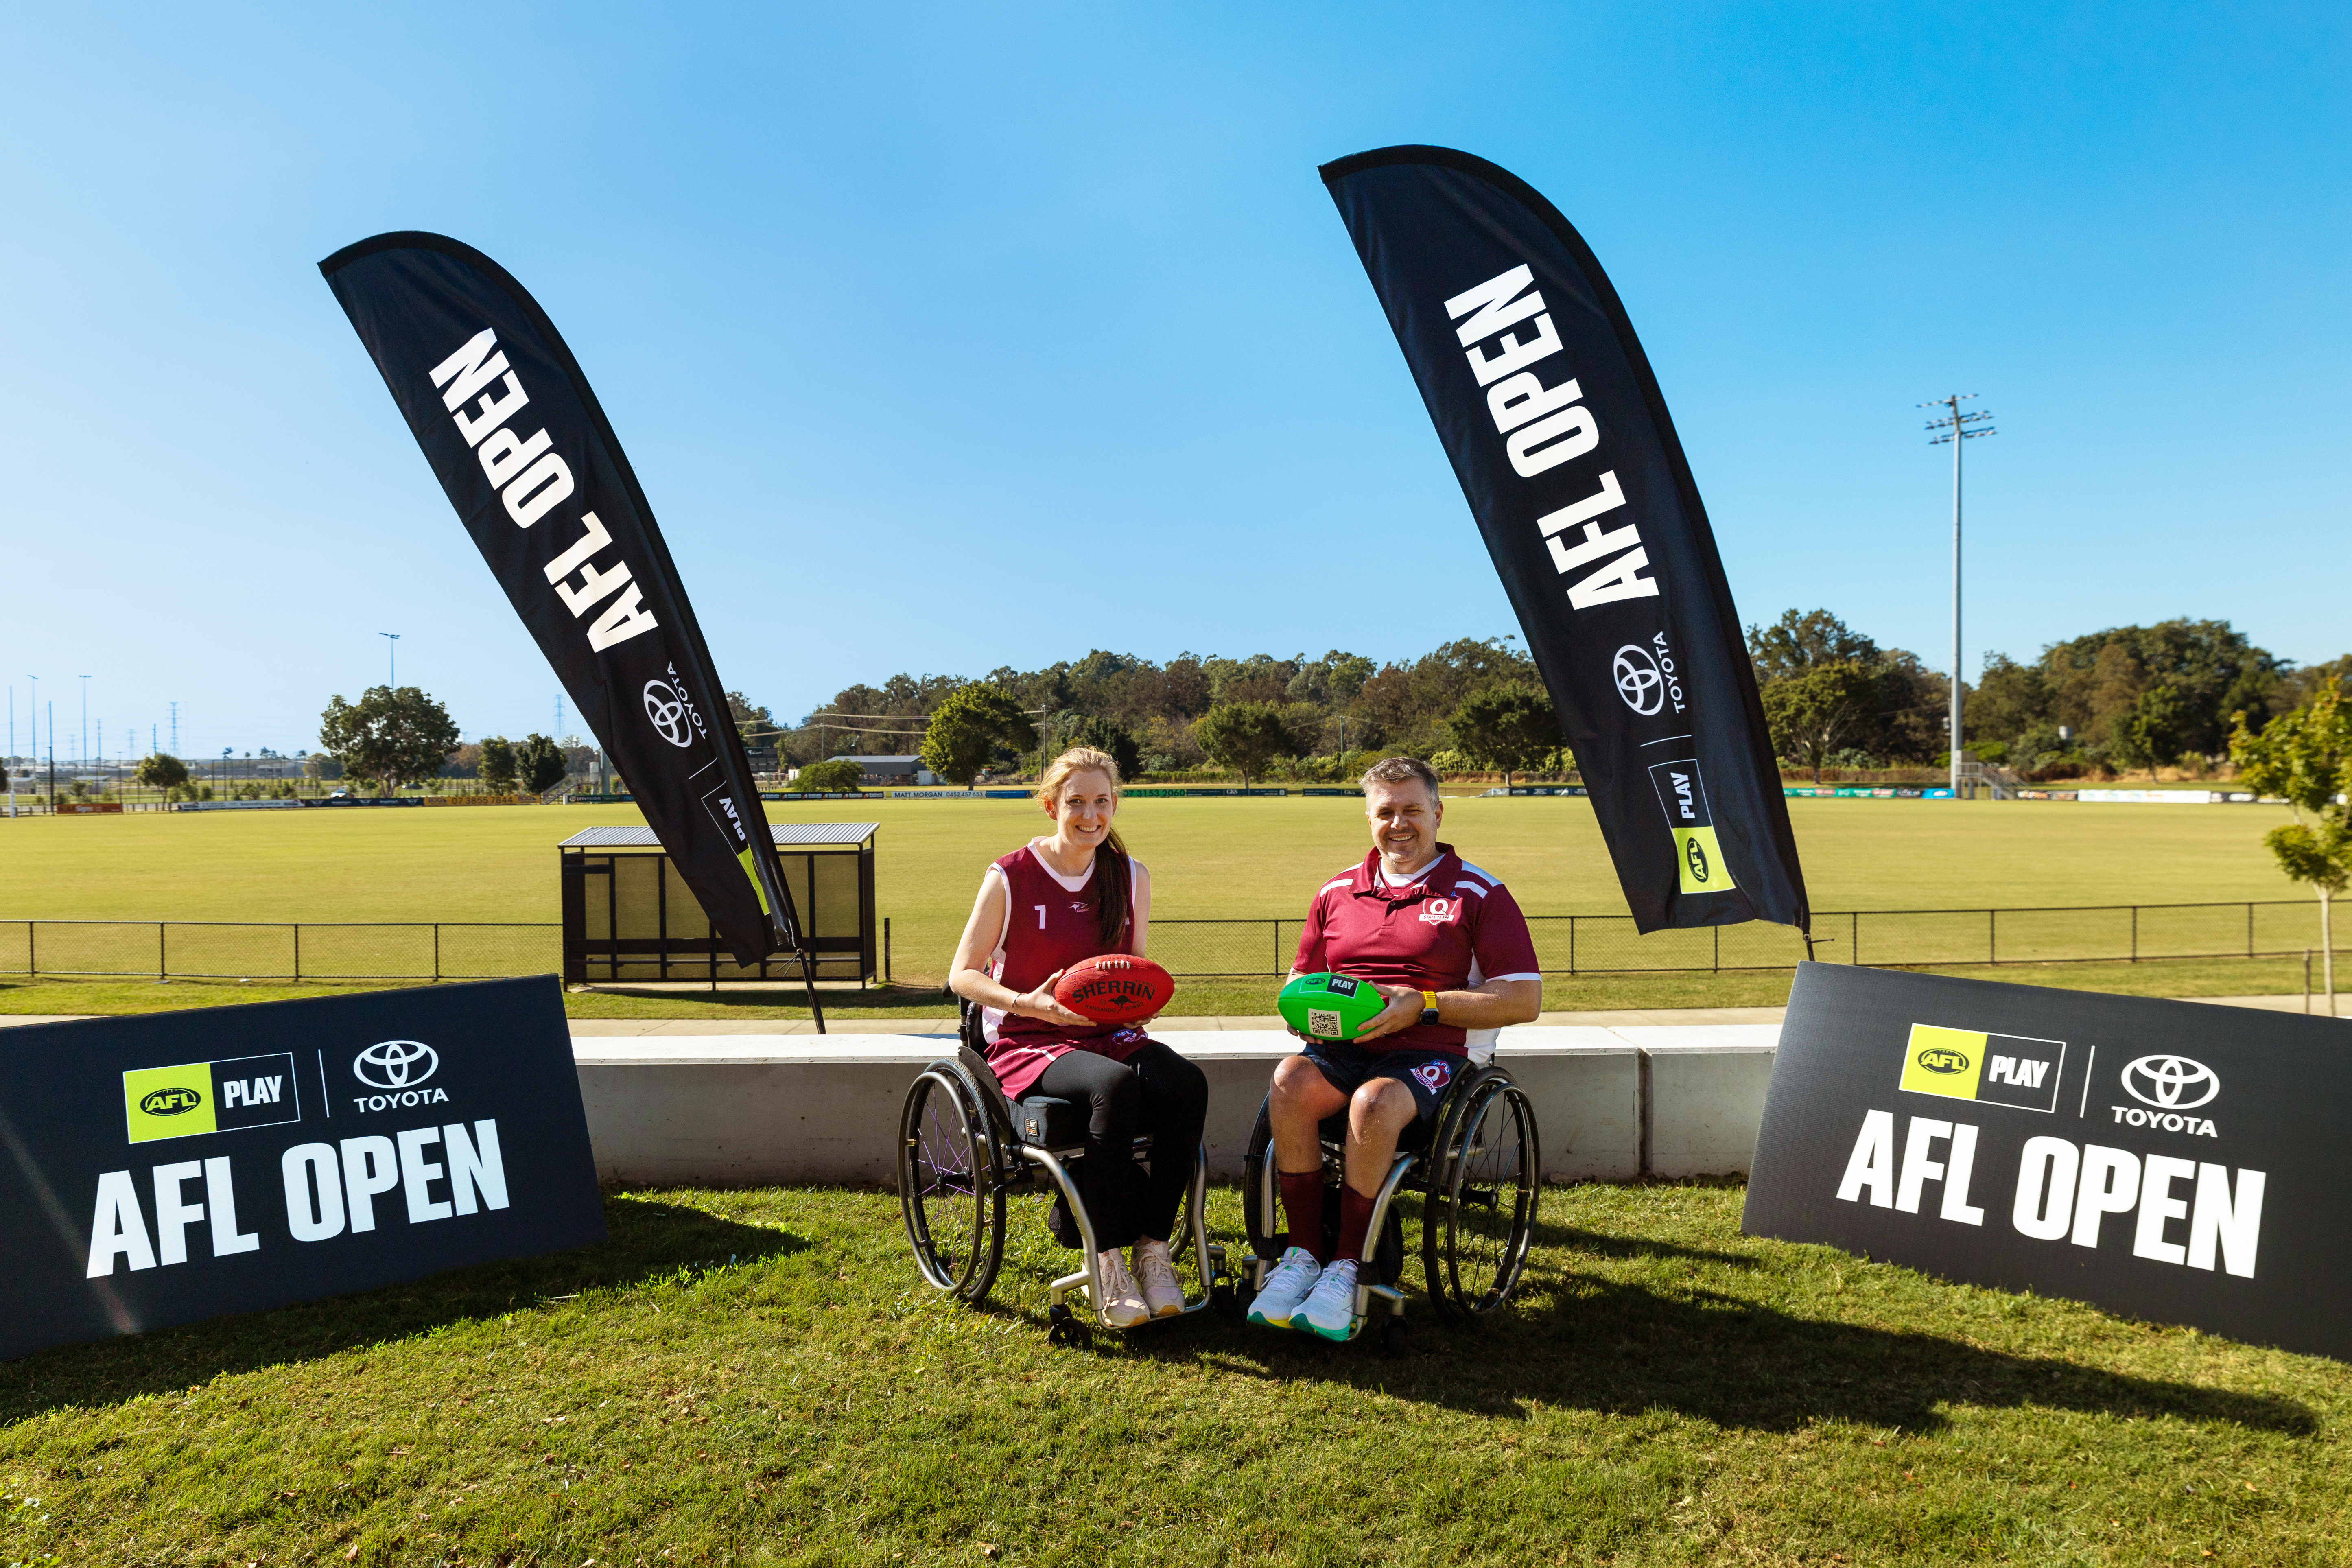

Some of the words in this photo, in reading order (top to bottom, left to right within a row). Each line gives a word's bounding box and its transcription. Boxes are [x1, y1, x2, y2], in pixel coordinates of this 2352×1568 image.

[1444, 264, 1599, 477] OPEN
[429, 328, 574, 528] OPEN
[1537, 470, 1659, 610] AFL
[544, 511, 658, 653] AFL
[1653, 631, 1685, 713] TOYOTA
[667, 661, 706, 739] TOYOTA
[1670, 773, 1695, 818] PLAY
[719, 797, 745, 841] PLAY
[1689, 840, 1707, 879] AFL
[1035, 905, 1045, 929] 1
[1430, 899, 1448, 915] Q
[1072, 980, 1156, 1004] SHERRIN
[1331, 978, 1354, 990] PLAY
[1085, 1004, 1116, 1013] KANGAROO
[1126, 1002, 1144, 1011] BRAND
[1413, 1069, 1424, 1080] STATE
[1424, 1079, 1434, 1090] TEAM
[1422, 1066, 1440, 1084] Q
[1919, 1052, 1966, 1072] AFL
[1989, 1055, 2050, 1088] PLAY
[144, 1091, 198, 1113] AFL
[224, 1075, 282, 1108] PLAY
[354, 1088, 449, 1112] TOYOTA
[2111, 1106, 2217, 1137] TOYOTA
[87, 1156, 259, 1279] AFL
[282, 1119, 509, 1241] OPEN
[1836, 1109, 1984, 1226] AFL
[2013, 1136, 2266, 1278] OPEN
